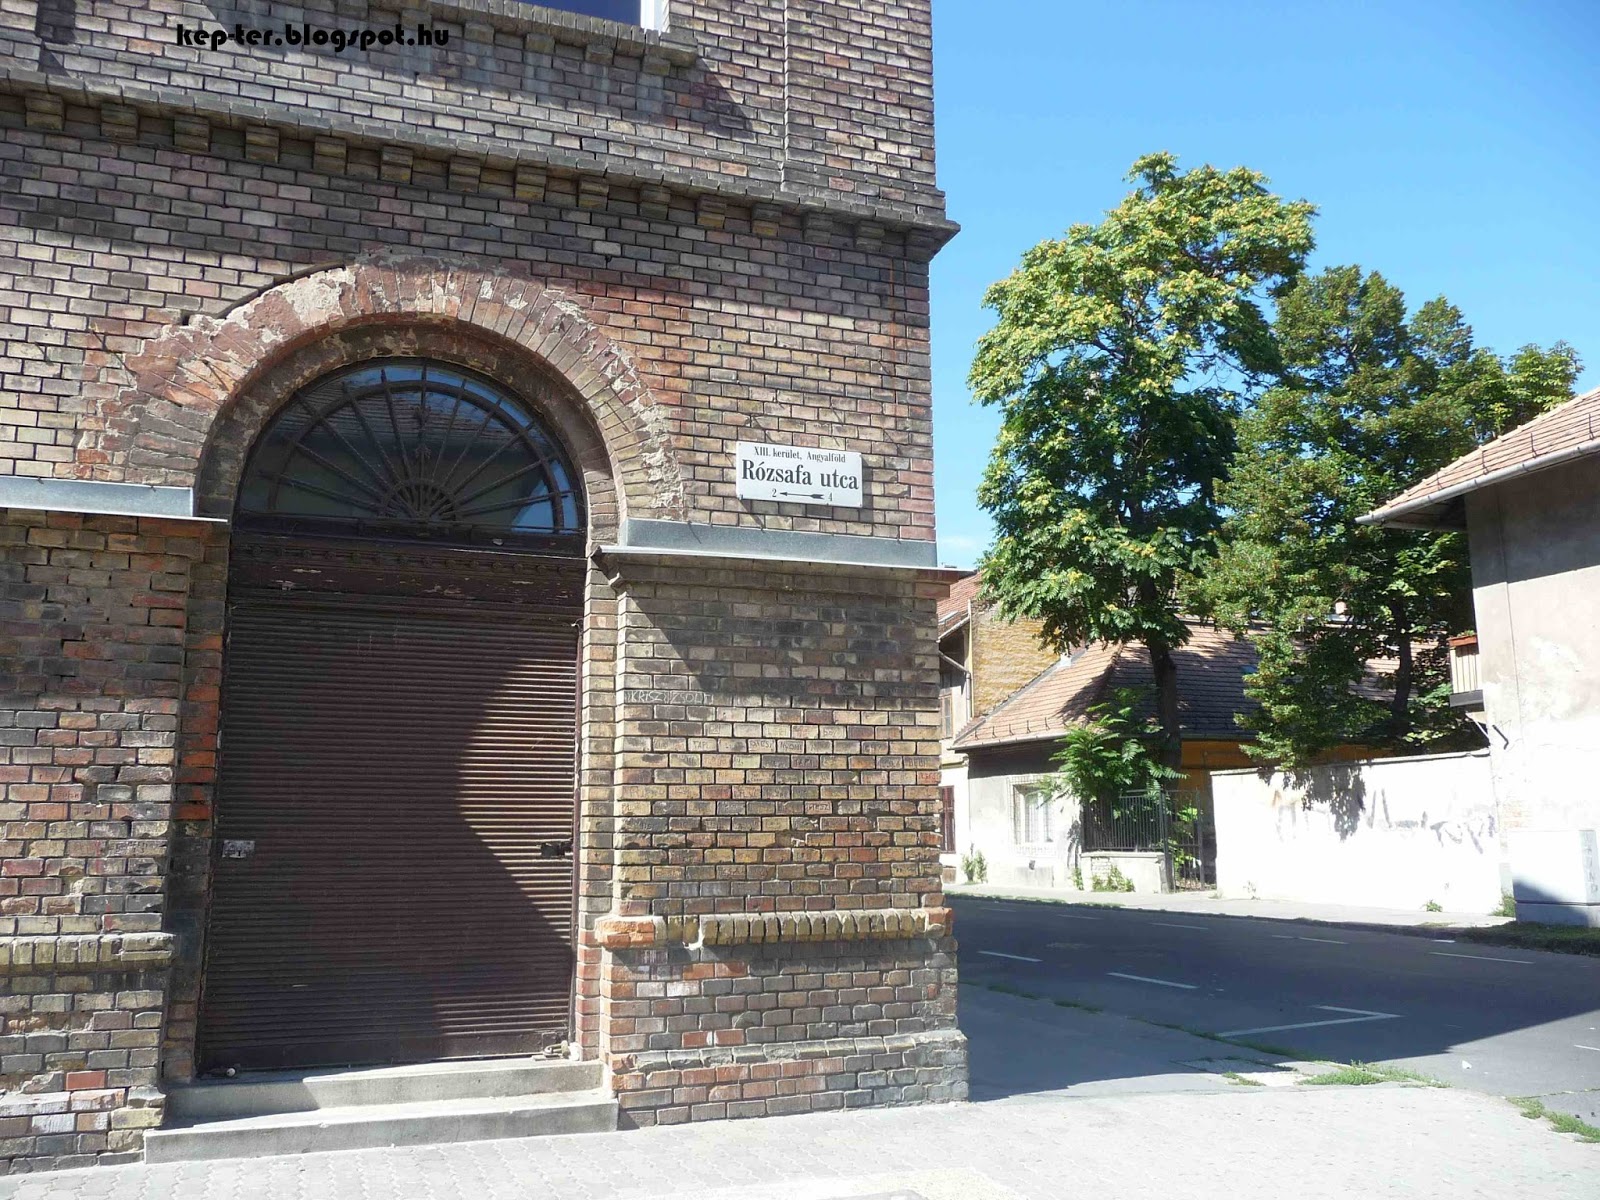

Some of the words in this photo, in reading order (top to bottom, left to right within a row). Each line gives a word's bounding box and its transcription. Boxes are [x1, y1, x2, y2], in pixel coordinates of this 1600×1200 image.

[754, 446, 771, 457] XIII.
[773, 448, 803, 460] kerület,
[807, 452, 846, 463] Angyalföld
[742, 459, 813, 486] Rózsafa
[820, 469, 859, 490] utca
[772, 488, 777, 497] 2
[827, 492, 833, 502] 4
